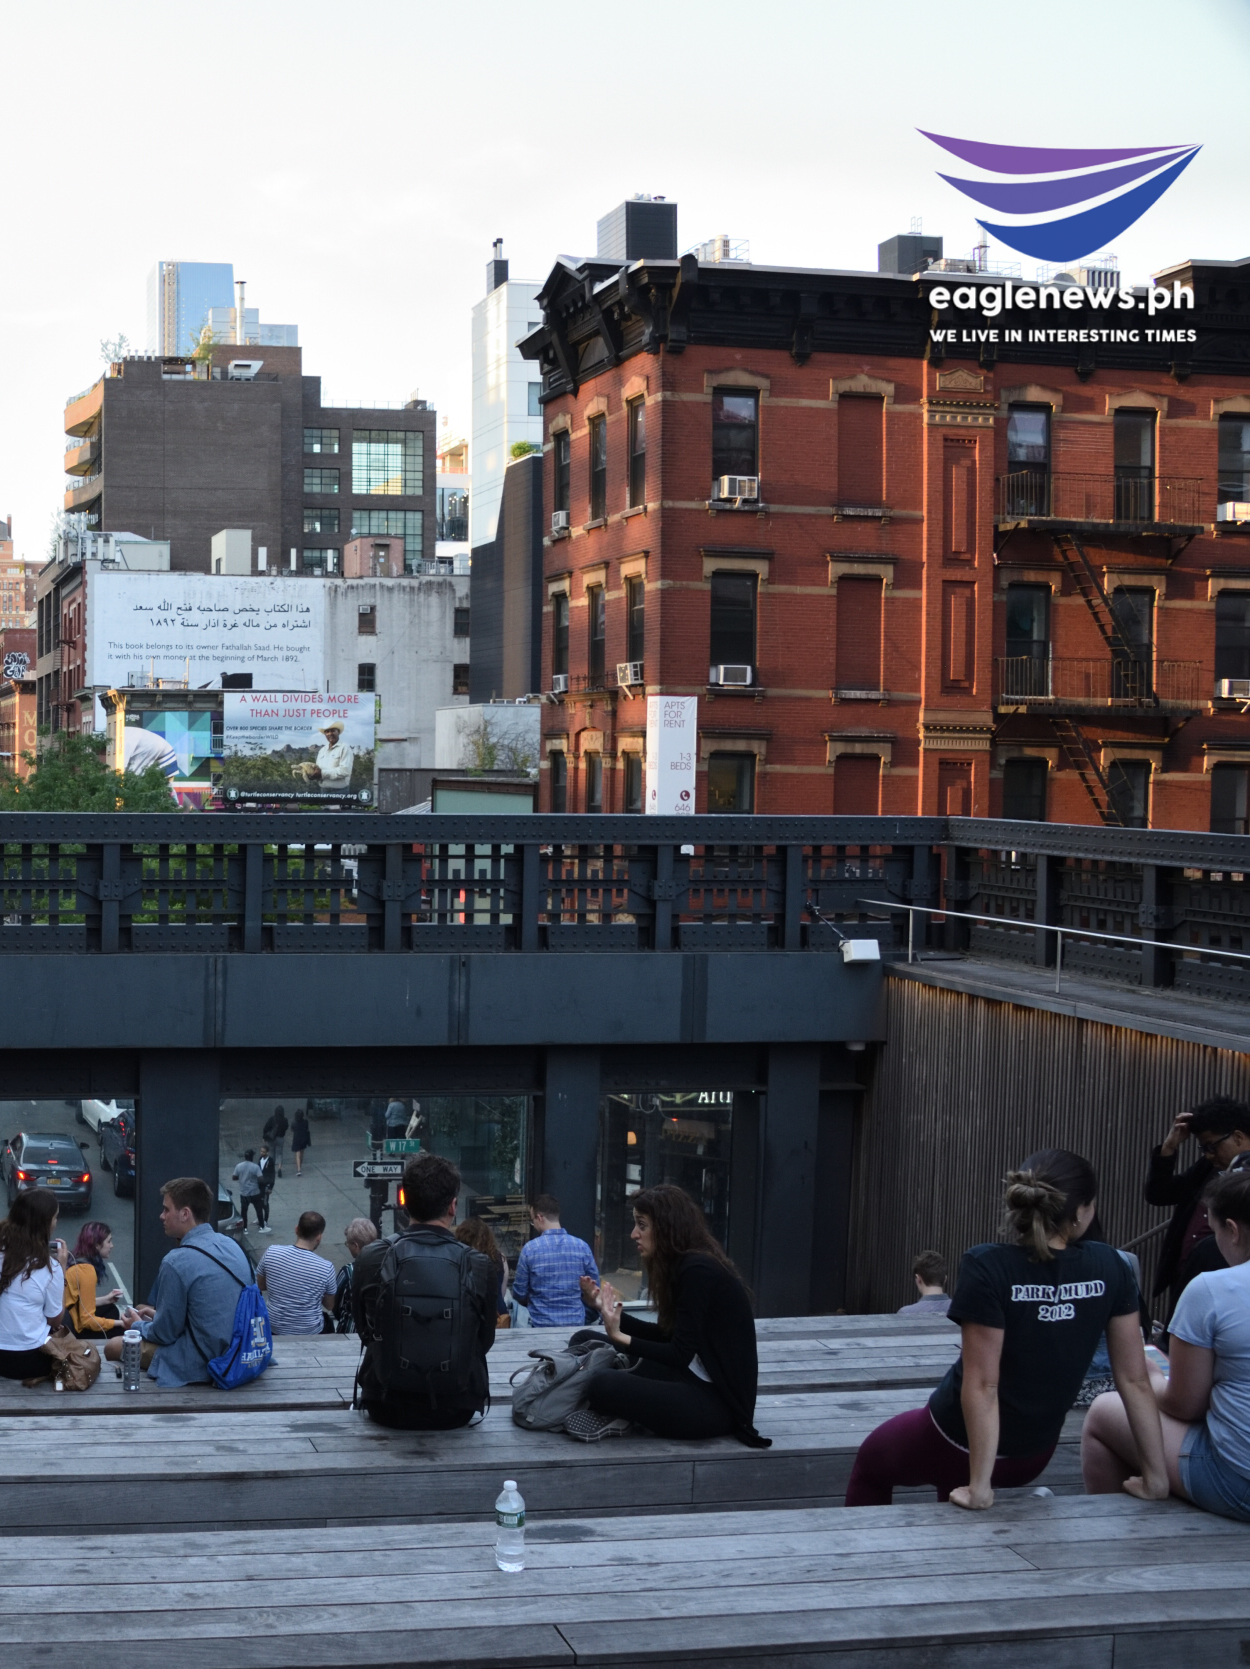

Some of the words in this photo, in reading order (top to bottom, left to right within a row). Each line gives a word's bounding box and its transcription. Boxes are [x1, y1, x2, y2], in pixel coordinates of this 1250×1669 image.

[157, 599, 172, 611] الله
[176, 603, 192, 616] فتح
[197, 604, 229, 614] صاحبه
[233, 604, 260, 615] يخص
[264, 603, 292, 616] الكتاب
[296, 604, 310, 613] هذا
[150, 618, 175, 626] ١٨٩٢
[181, 618, 198, 627] سنة
[203, 619, 219, 630] اذار
[223, 620, 238, 630] غرة
[243, 619, 260, 627] ماله
[264, 622, 277, 630] من
[282, 620, 310, 631] اشتراه
[146, 643, 173, 651] belongs
[286, 645, 310, 653] bought
[212, 655, 245, 663] beginning
[240, 695, 247, 703] A
[251, 695, 278, 703] WALL
[283, 694, 323, 703] DIVIDES
[328, 695, 359, 703] MORE
[664, 701, 685, 709] APTS
[250, 709, 278, 717] THAN
[282, 709, 306, 717] JUST
[311, 709, 348, 718] PEOPLE
[664, 720, 685, 728] RENT
[680, 753, 691, 761] 1-3
[671, 762, 691, 770] BEDS
[296, 792, 357, 800] turtleconservancy.org
[390, 1142, 396, 1151] W
[399, 1141, 406, 1151] 17
[1038, 1303, 1075, 1321] 2012
